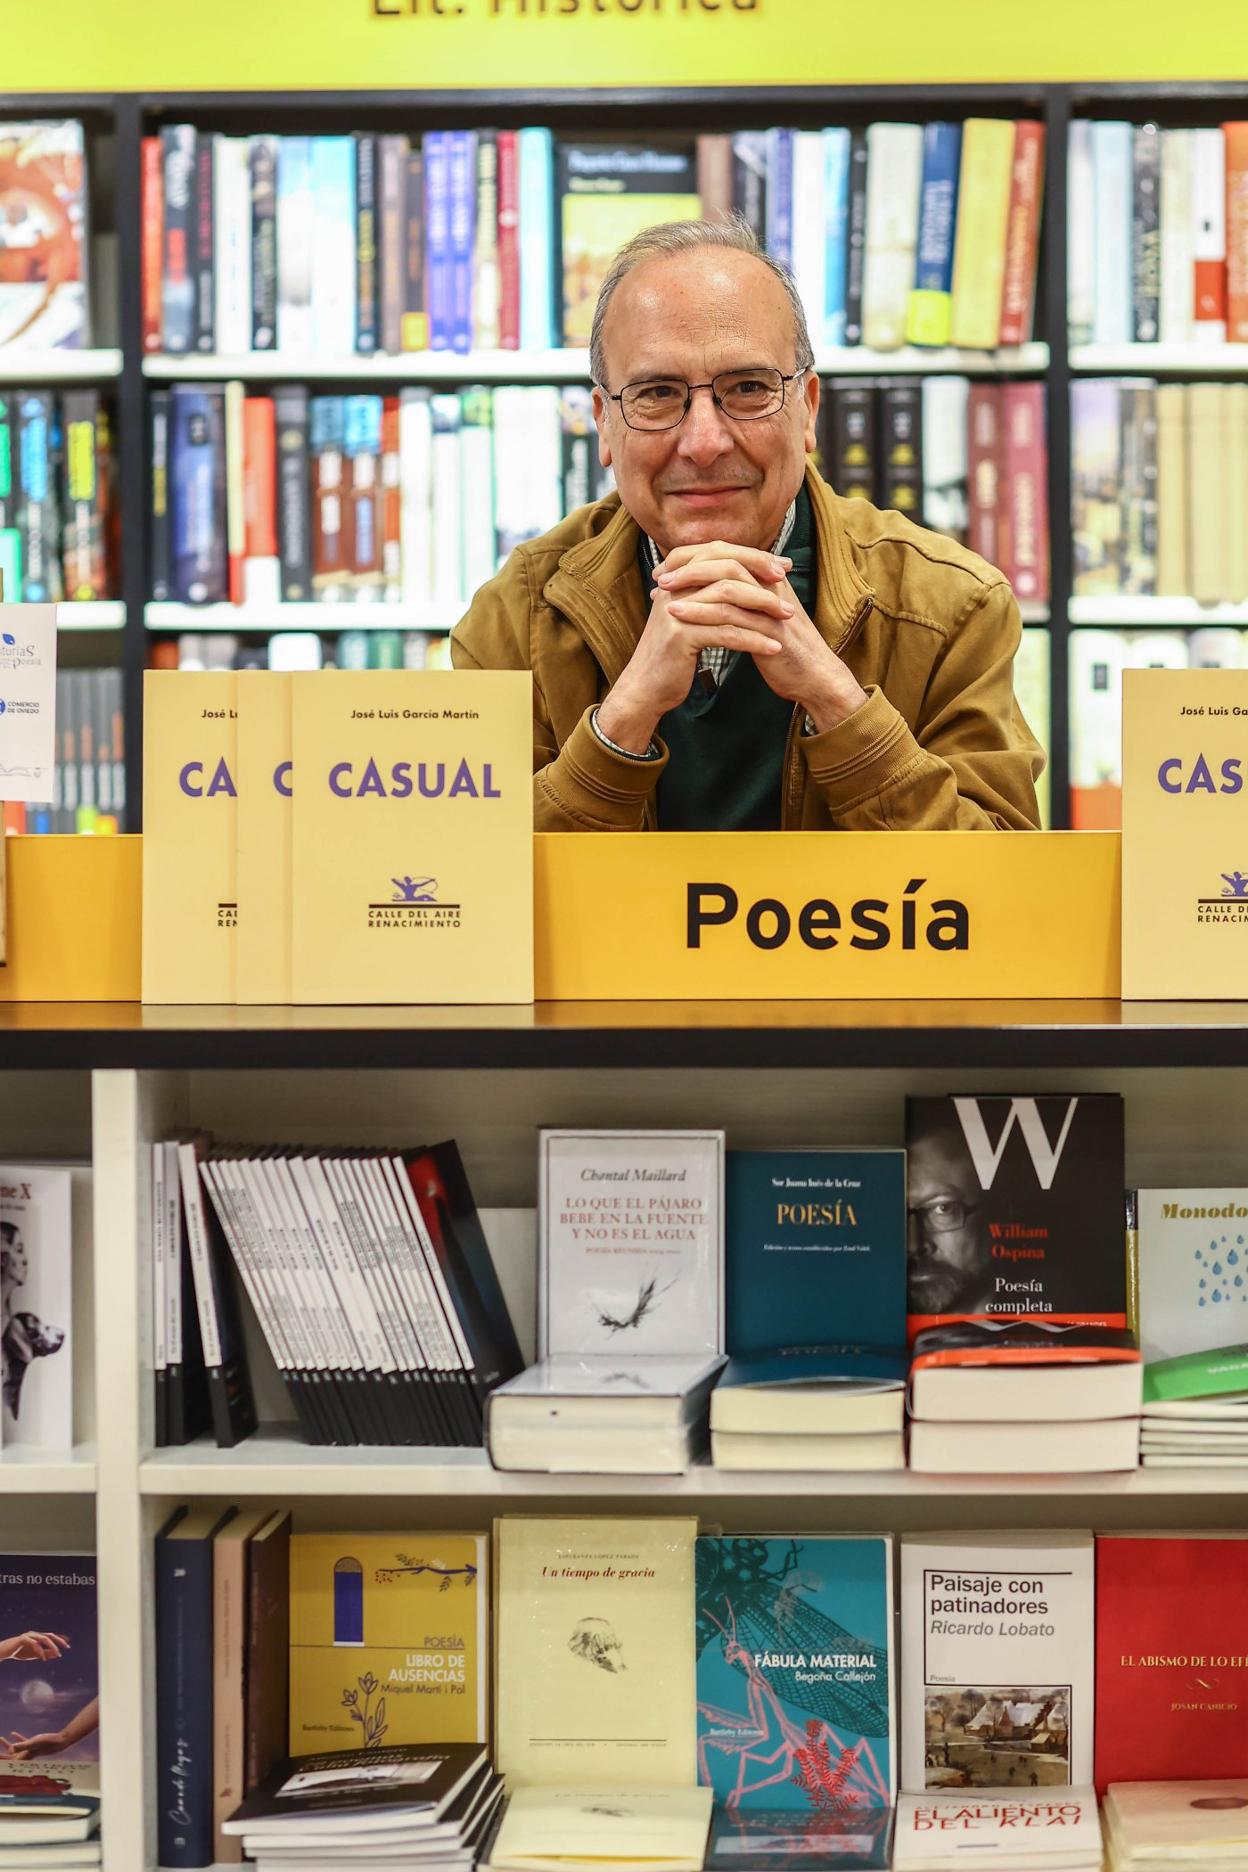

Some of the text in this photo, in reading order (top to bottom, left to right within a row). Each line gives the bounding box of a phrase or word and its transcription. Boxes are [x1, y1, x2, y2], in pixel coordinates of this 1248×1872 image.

[201, 709, 226, 719] José
[350, 709, 480, 720] José Luis García Martín
[1180, 706, 1205, 716] José
[1208, 706, 1229, 716] Luis
[328, 756, 502, 798] CASUAL
[1157, 752, 1244, 794] CAS
[368, 910, 461, 919] CALLE DEL AIRE
[687, 879, 970, 951] Poesía
[1197, 905, 1248, 913] CALLE D
[368, 920, 461, 929] RENACIMIENTO
[953, 1097, 1079, 1191] W
[580, 1168, 687, 1182] Chantal Maillard
[564, 1195, 703, 1211] LO QUE EL PÁJARO
[560, 1212, 707, 1225] BEBE EN LA FUENTE
[776, 1199, 858, 1226] POESÍA
[571, 1228, 697, 1240] Y NO ES EL AGUA
[988, 1223, 1049, 1239] William
[991, 1244, 1046, 1263] Ospina
[994, 1277, 1043, 1293] Poesía
[984, 1297, 1053, 1316] completa
[26, 1575, 43, 1585] no
[45, 1572, 96, 1586] estabas
[561, 1566, 600, 1581] tiempo
[602, 1566, 617, 1577] de
[618, 1567, 656, 1579] gracia
[930, 1574, 1044, 1597] Paisaje con
[930, 1597, 1049, 1616] patinadores
[930, 1620, 1055, 1637] Ricardo Lobato
[406, 1654, 465, 1668] LIBRO DE
[754, 1651, 877, 1668] FÁBULA MATERIAL
[1120, 1655, 1136, 1667] EL
[1138, 1655, 1188, 1667] ABISMO
[1190, 1655, 1207, 1667] DE
[1210, 1655, 1228, 1667] LO
[388, 1668, 465, 1683] AUSENCIAS
[914, 1818, 980, 1831] DEL
